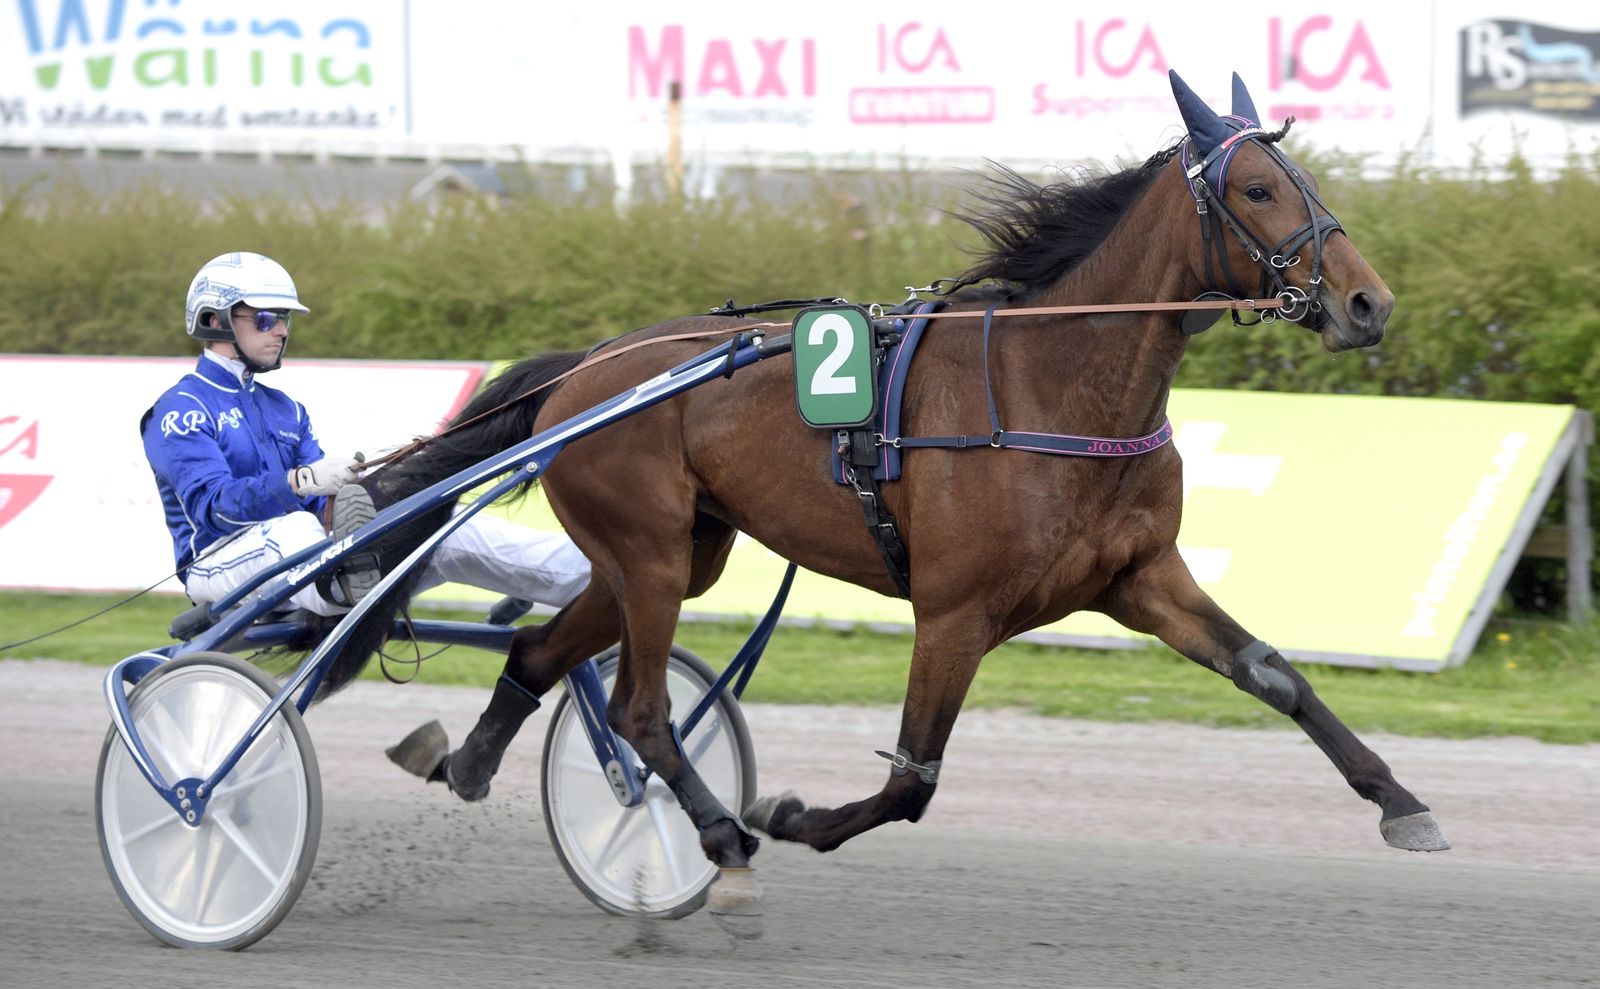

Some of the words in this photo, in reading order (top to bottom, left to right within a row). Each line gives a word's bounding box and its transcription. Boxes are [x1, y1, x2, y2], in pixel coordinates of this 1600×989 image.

[628, 24, 817, 99] MAXI
[877, 21, 962, 73] ICA
[1075, 18, 1170, 79] ICA
[1268, 14, 1392, 91] ICA
[808, 313, 857, 395] 2
[160, 410, 207, 438] RP
[1087, 435, 1161, 453] JOANNA
